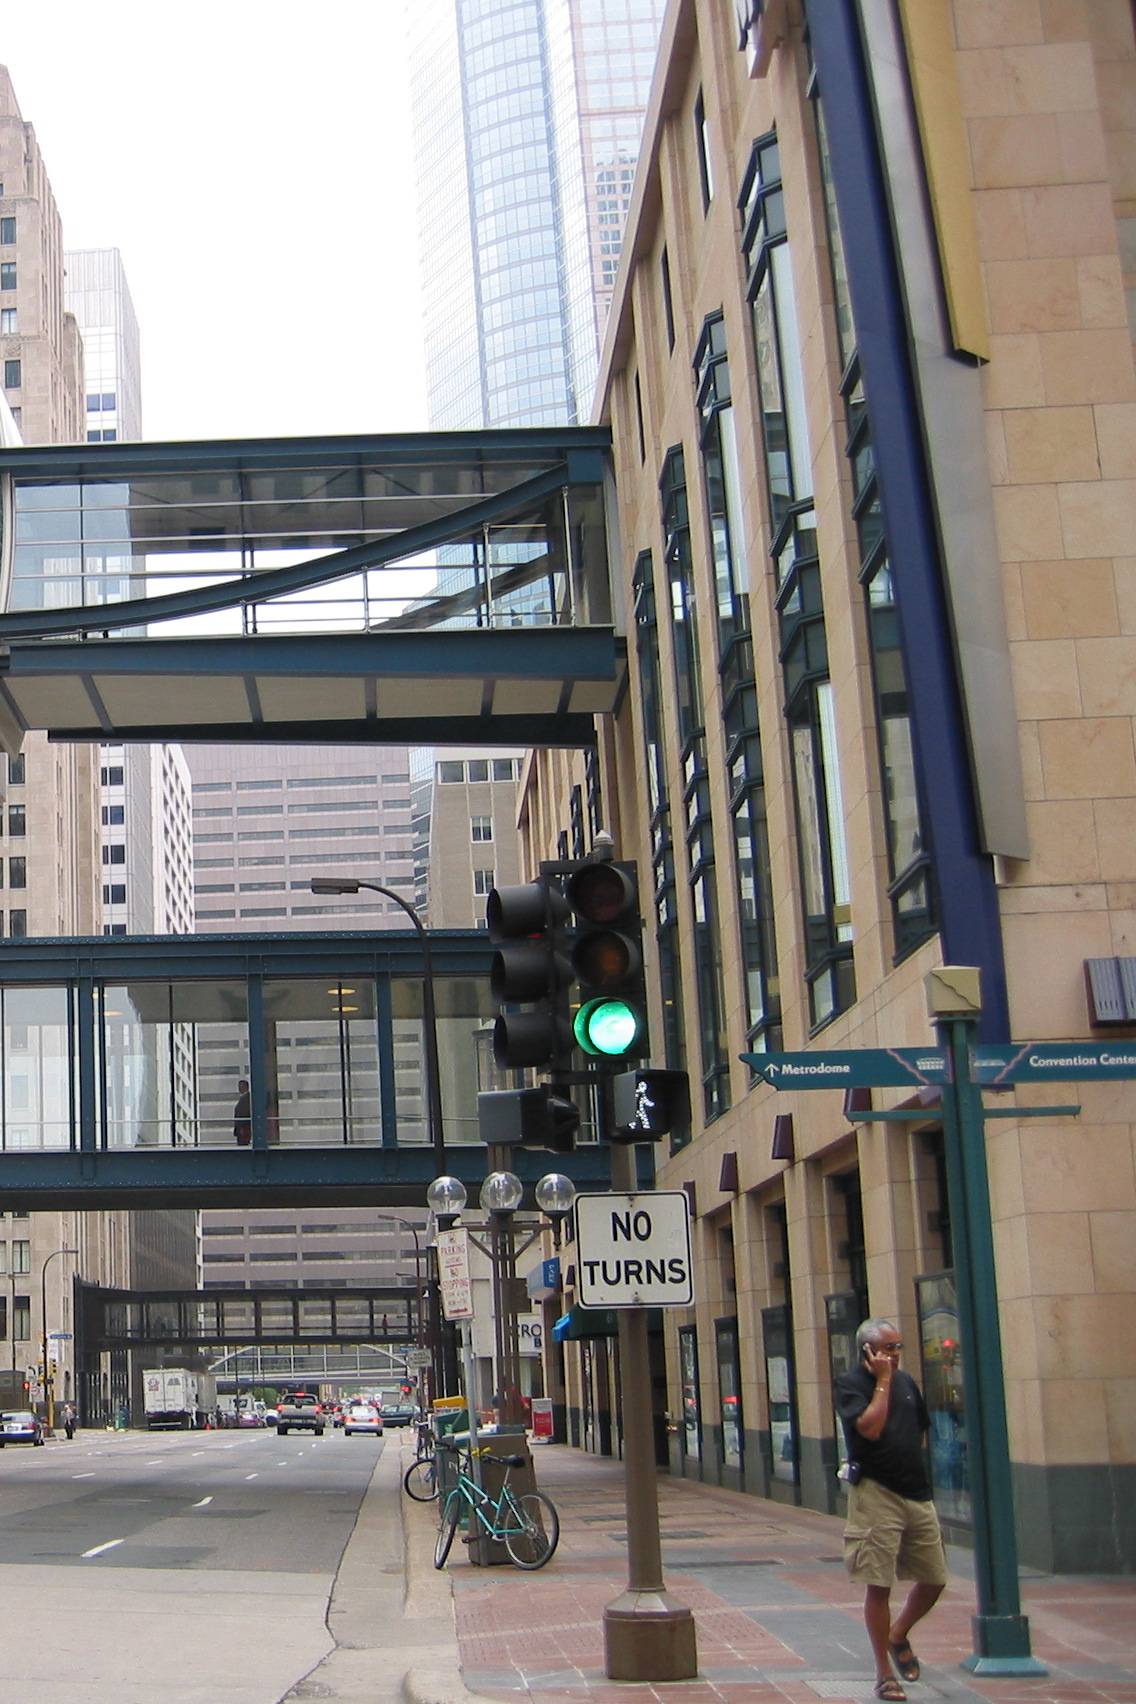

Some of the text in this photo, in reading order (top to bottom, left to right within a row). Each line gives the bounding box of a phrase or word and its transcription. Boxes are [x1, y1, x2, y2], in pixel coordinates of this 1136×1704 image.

[781, 1062, 850, 1075] Metrodome
[1029, 1053, 1136, 1067] Convention Cente
[611, 1210, 652, 1241] NO
[583, 1258, 686, 1286] TURNS
